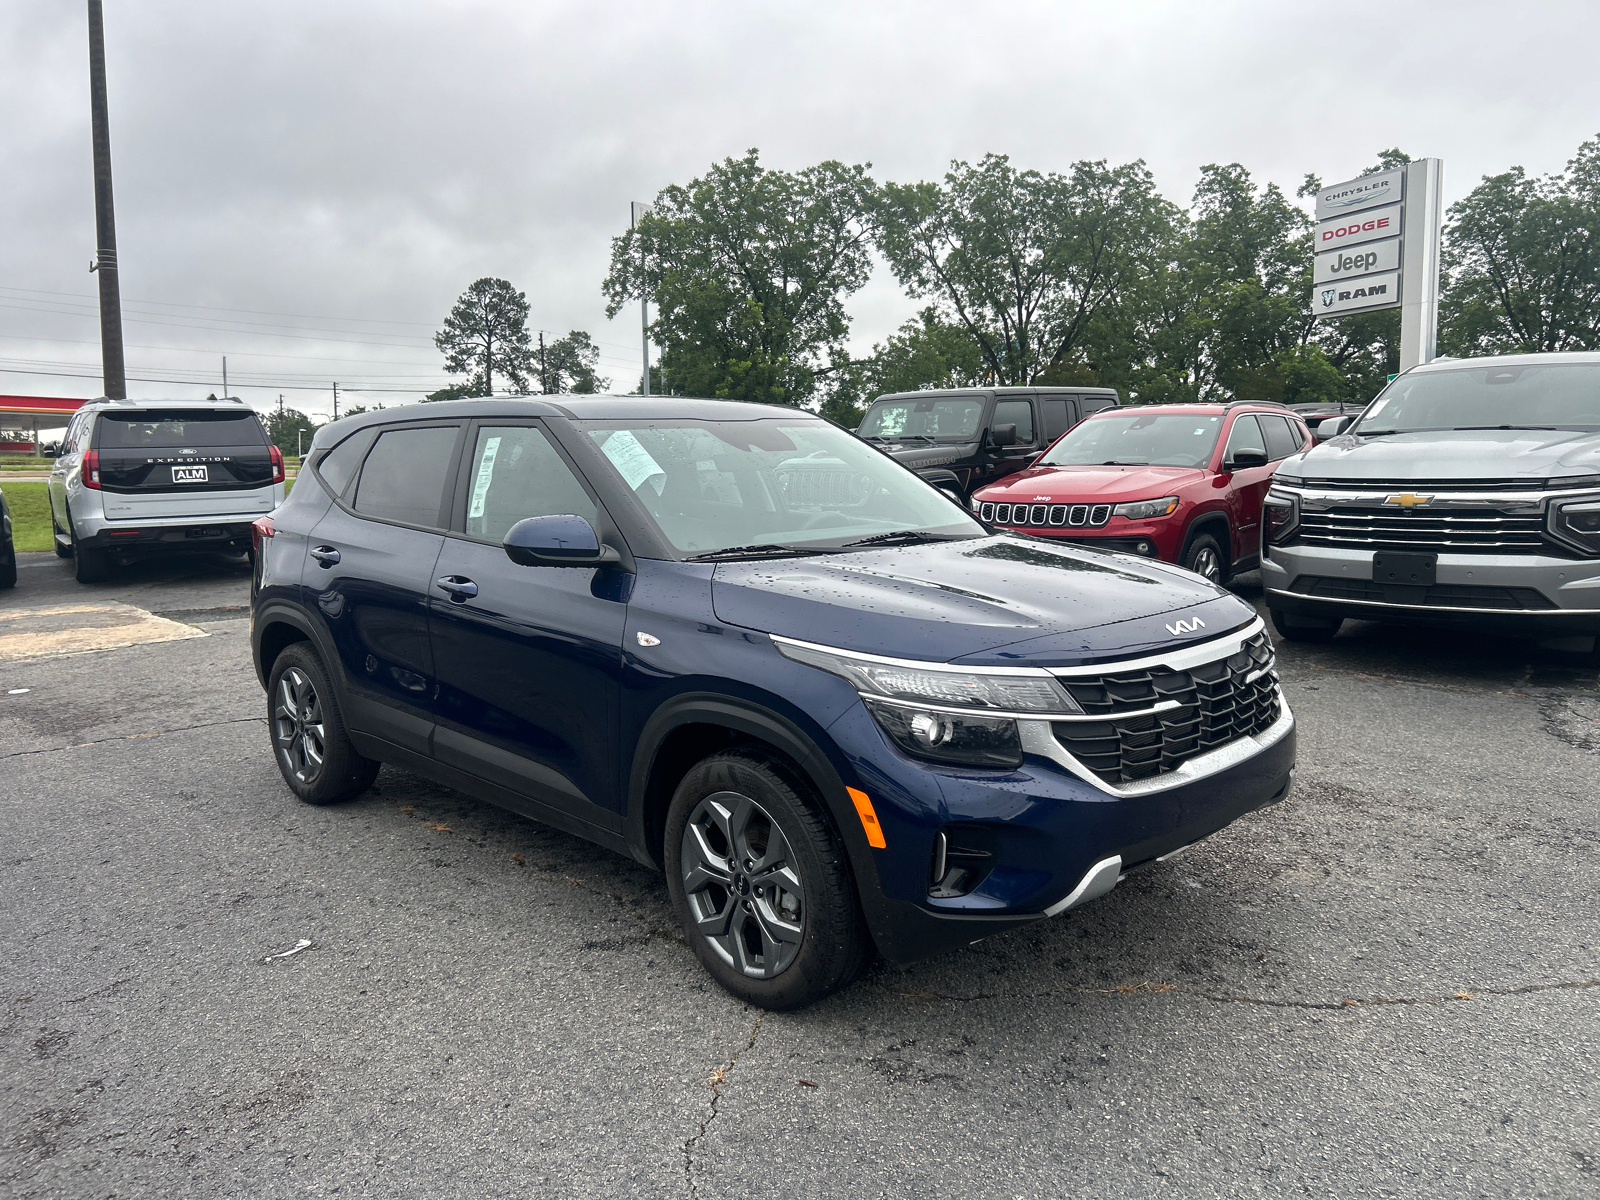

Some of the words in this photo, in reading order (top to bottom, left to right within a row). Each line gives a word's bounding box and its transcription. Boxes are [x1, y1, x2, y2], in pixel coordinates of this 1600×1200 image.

[1325, 180, 1389, 201] CHRYSLER
[1322, 217, 1390, 241] DODGE
[1330, 251, 1378, 273] Jeep
[1338, 284, 1387, 301] RAM
[903, 456, 956, 469] UBICON
[176, 469, 204, 479] ALM
[1165, 616, 1205, 636] KIA
